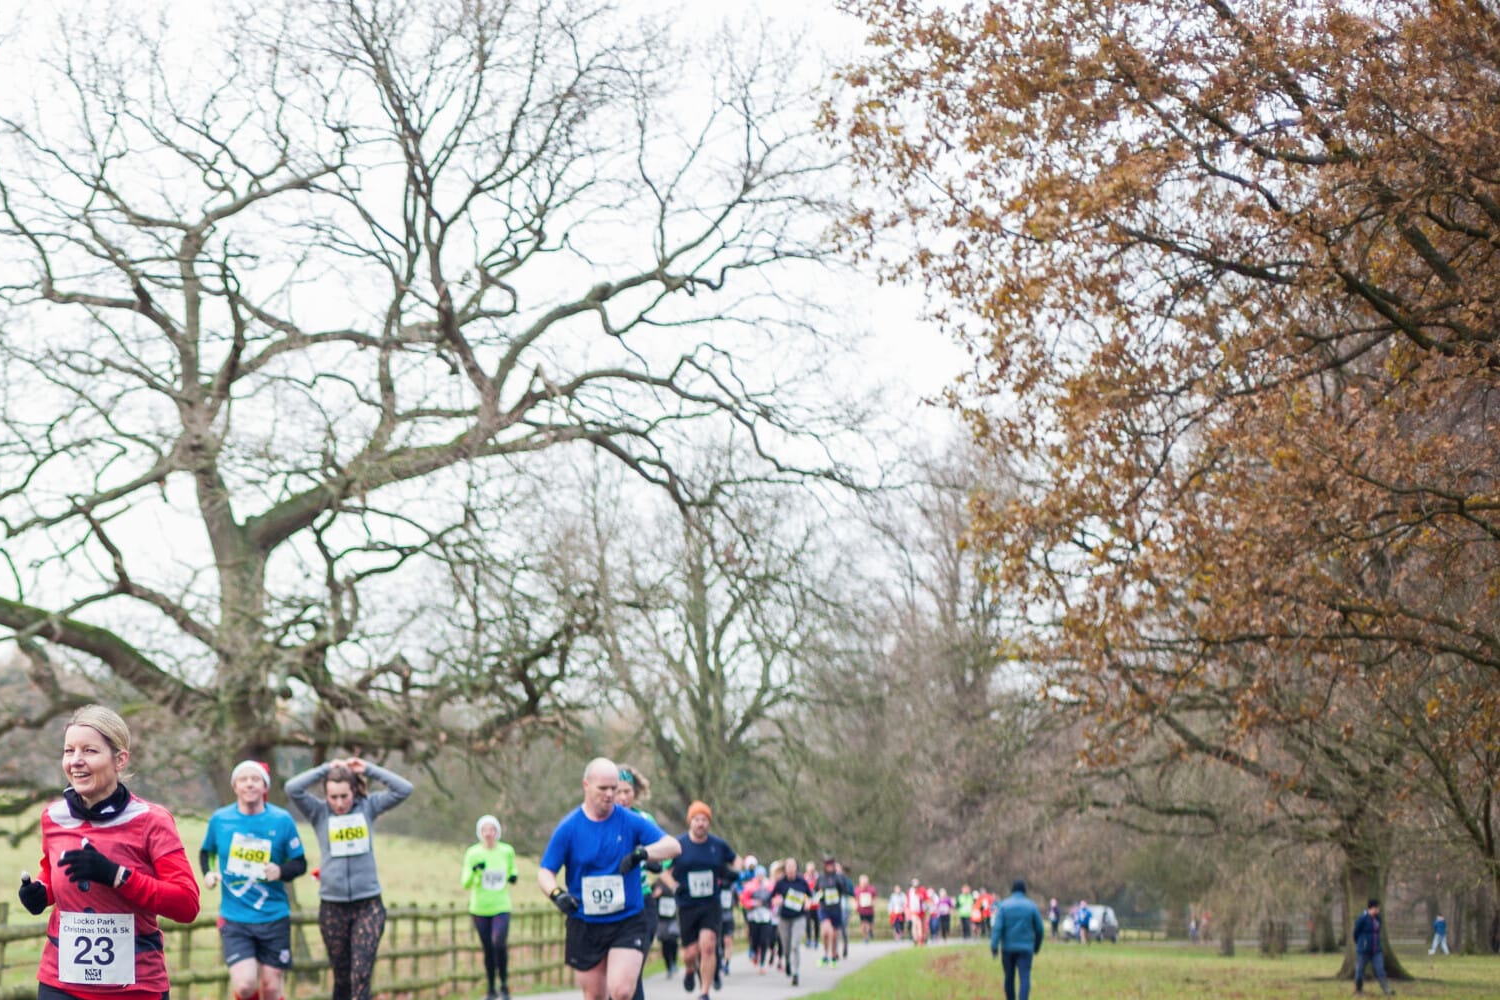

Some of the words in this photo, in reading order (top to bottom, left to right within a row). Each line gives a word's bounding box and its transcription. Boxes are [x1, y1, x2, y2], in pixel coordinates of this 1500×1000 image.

[592, 888, 614, 904] 99
[63, 925, 95, 934] Christmas
[73, 936, 115, 965] 23
